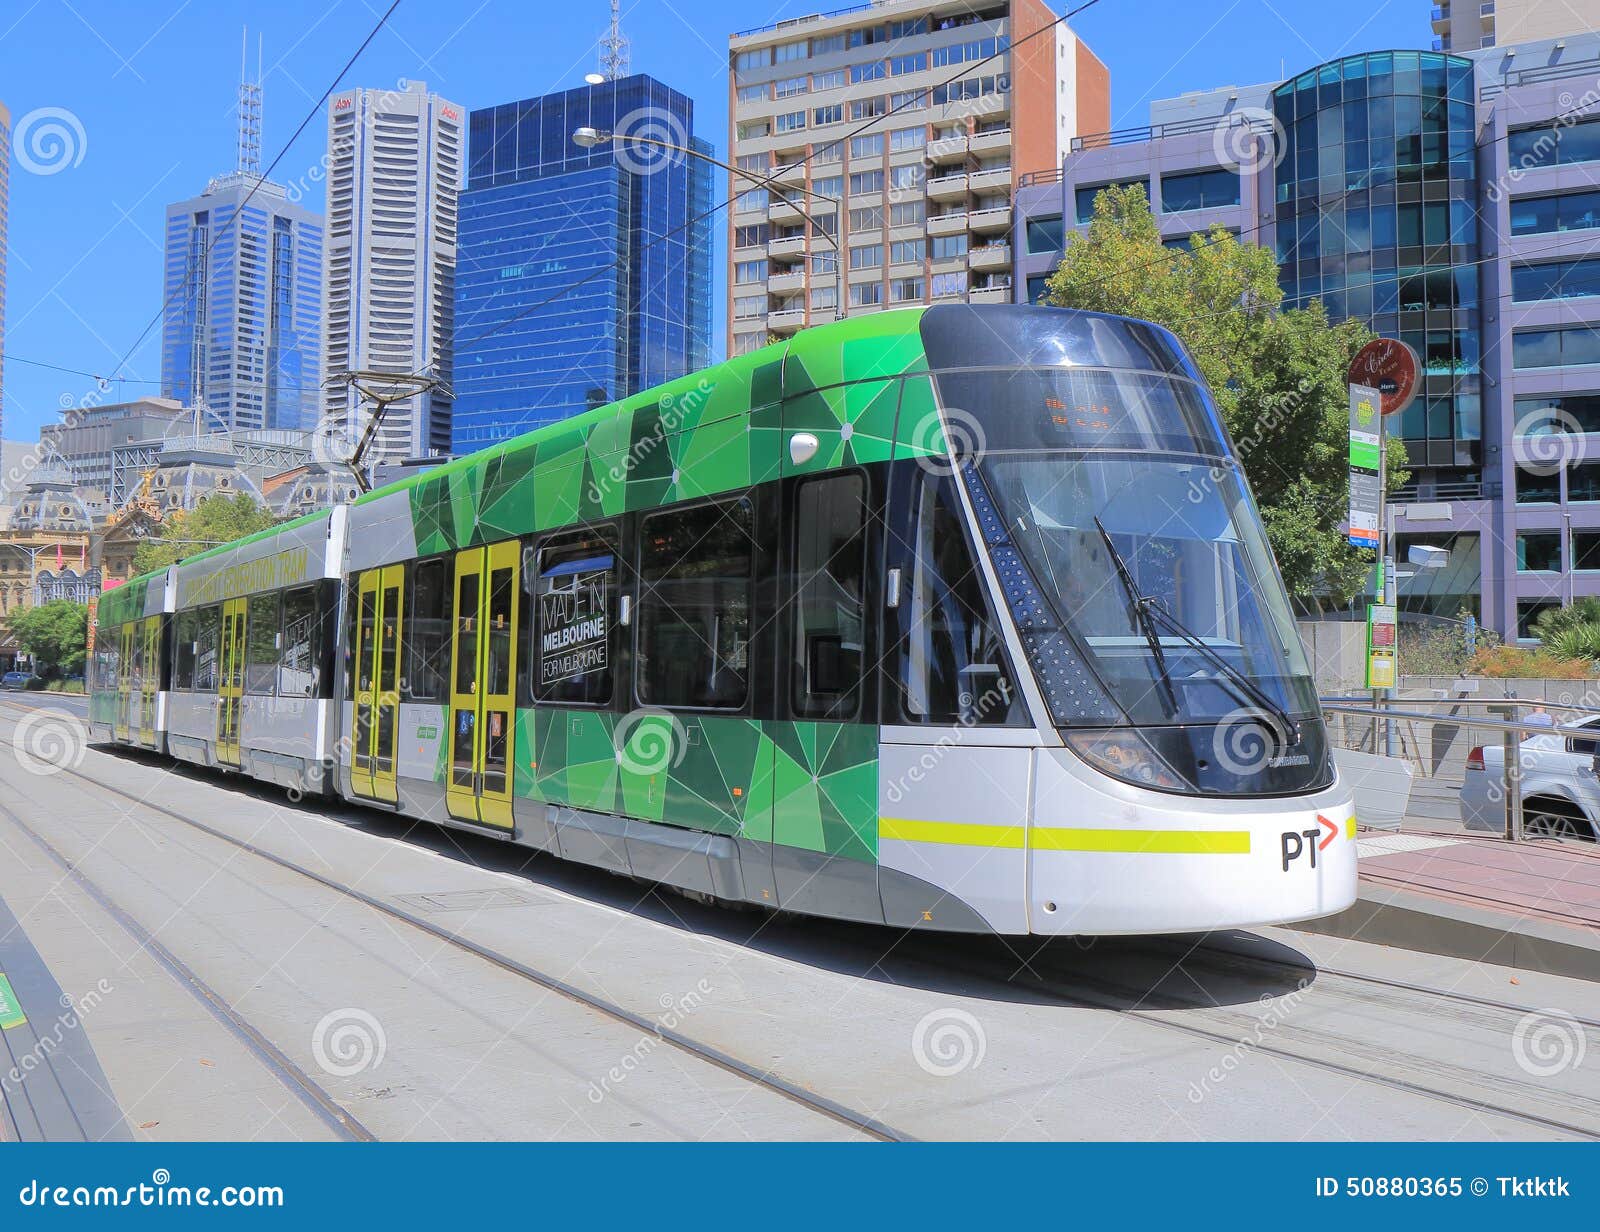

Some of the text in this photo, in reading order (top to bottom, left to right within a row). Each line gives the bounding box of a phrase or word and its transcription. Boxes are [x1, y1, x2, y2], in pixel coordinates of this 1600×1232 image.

[543, 578, 605, 631] MADE IN
[543, 616, 605, 653] MELBOURNE
[543, 646, 605, 678] FOR MELBOURNE
